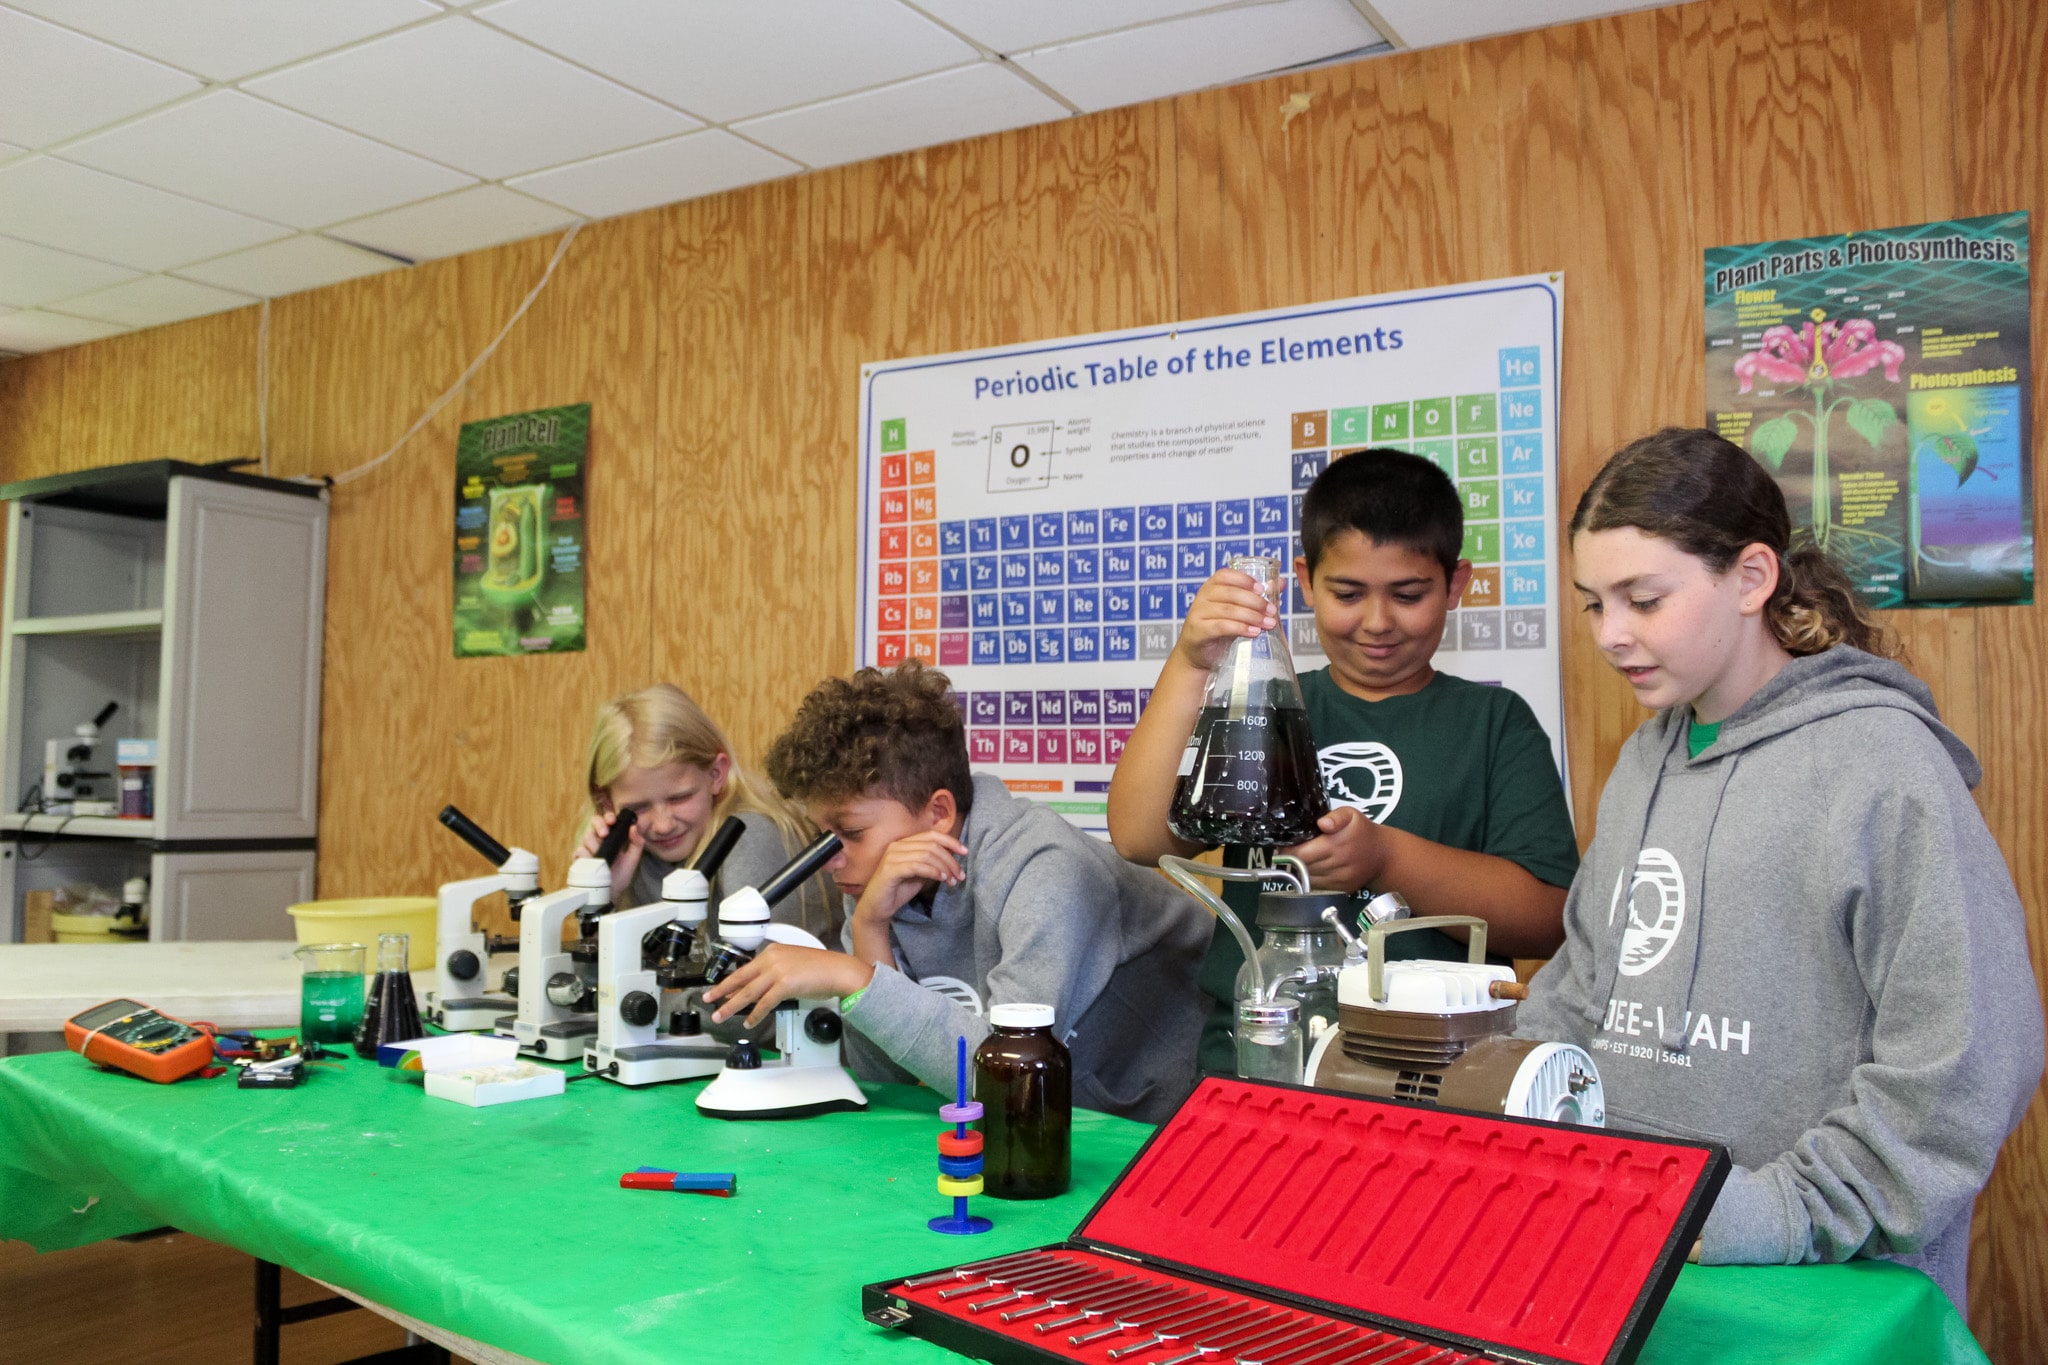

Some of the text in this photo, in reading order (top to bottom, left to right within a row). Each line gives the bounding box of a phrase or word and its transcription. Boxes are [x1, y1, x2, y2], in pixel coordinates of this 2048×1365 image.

[1716, 236, 2016, 293] Plant Parts & Photosynthesis
[1736, 289, 1776, 304] Flower
[974, 326, 1404, 400] Periodic Table of the Elements
[1506, 358, 1534, 376] He
[1910, 366, 2017, 390] Photosynthesis
[1426, 409, 1440, 425] O
[1471, 405, 1482, 422] F
[1509, 402, 1534, 418] Ne
[1112, 429, 1149, 440] Chemistry
[1166, 426, 1193, 436] branch
[1195, 425, 1203, 433] of
[1204, 421, 1236, 434] physical
[1237, 418, 1266, 429] science
[1304, 422, 1315, 437] B
[1344, 418, 1355, 432] C
[1384, 414, 1396, 430] N
[889, 428, 898, 442] H
[994, 432, 1002, 444] 8
[1111, 442, 1126, 450] that
[1128, 440, 1156, 450] studies
[1158, 438, 1170, 447] the
[1010, 444, 1030, 468] O
[1110, 446, 1234, 463] properties and change of matter
[1468, 448, 1488, 465] Cl
[1512, 446, 1533, 462] Ar
[888, 463, 900, 478] Li
[914, 462, 930, 474] Be
[1300, 461, 1318, 478] Al
[1469, 492, 1490, 508] Br
[1513, 489, 1534, 506] Kr
[885, 500, 904, 514] Na
[914, 498, 933, 514] Mg
[1146, 515, 1167, 530] Co
[1186, 511, 1203, 528] Ni
[1222, 510, 1244, 526] Cu
[1260, 507, 1282, 523] Zn
[1009, 525, 1020, 540] V
[1040, 522, 1057, 538] Cr
[1072, 520, 1094, 536] Mn
[1110, 517, 1128, 532] Fe
[916, 534, 932, 547] Ca
[945, 530, 960, 545] Sc
[976, 526, 990, 542] Ti
[1513, 533, 1536, 549] Xe
[889, 536, 899, 549] K
[1075, 558, 1092, 574] Tc
[1109, 556, 1130, 572] Ru
[1146, 554, 1167, 570] Rh
[1184, 551, 1204, 568] Pd
[1222, 550, 1243, 566] A
[950, 568, 958, 582] Y
[977, 565, 992, 580] Zr
[1006, 562, 1026, 578] Nb
[1038, 561, 1060, 576] Mo
[884, 571, 902, 585] Rb
[916, 570, 932, 584] Sr
[1512, 576, 1538, 593] Rn
[1470, 578, 1491, 595] At
[1008, 600, 1024, 616] Ta
[1042, 599, 1056, 614] W
[1074, 598, 1094, 613] Re
[1108, 596, 1130, 611] Os
[1149, 594, 1163, 610] Ir
[1185, 592, 1197, 608] P
[885, 608, 901, 621] Cs
[915, 606, 932, 620] Ba
[978, 601, 994, 617] Hf
[1472, 622, 1492, 638] Ts
[1513, 621, 1540, 641] Og
[914, 642, 931, 656] Ra
[979, 639, 995, 654] Rf
[1008, 638, 1026, 654] Db
[1040, 638, 1059, 656] Sg
[1074, 636, 1094, 652] Bh
[1110, 636, 1130, 651] Hs
[1146, 634, 1166, 650] Mt
[885, 644, 900, 657] Fr
[976, 700, 995, 716] Ce
[1011, 700, 1028, 715] Pr
[1042, 700, 1062, 715] Nd
[1073, 700, 1097, 714] Pm
[1108, 698, 1132, 714] Sm
[1242, 715, 1268, 727] 1600
[976, 738, 994, 752] Th
[1010, 739, 1028, 753] Pa
[1047, 738, 1058, 753] U
[1075, 738, 1096, 756] Np
[1239, 750, 1266, 761] 1200
[1236, 780, 1258, 791] 800
[1262, 882, 1284, 892] NJY
[1614, 1042, 1628, 1055] EST
[1630, 1045, 1653, 1060] 1920
[1662, 1051, 1692, 1068] 5681
